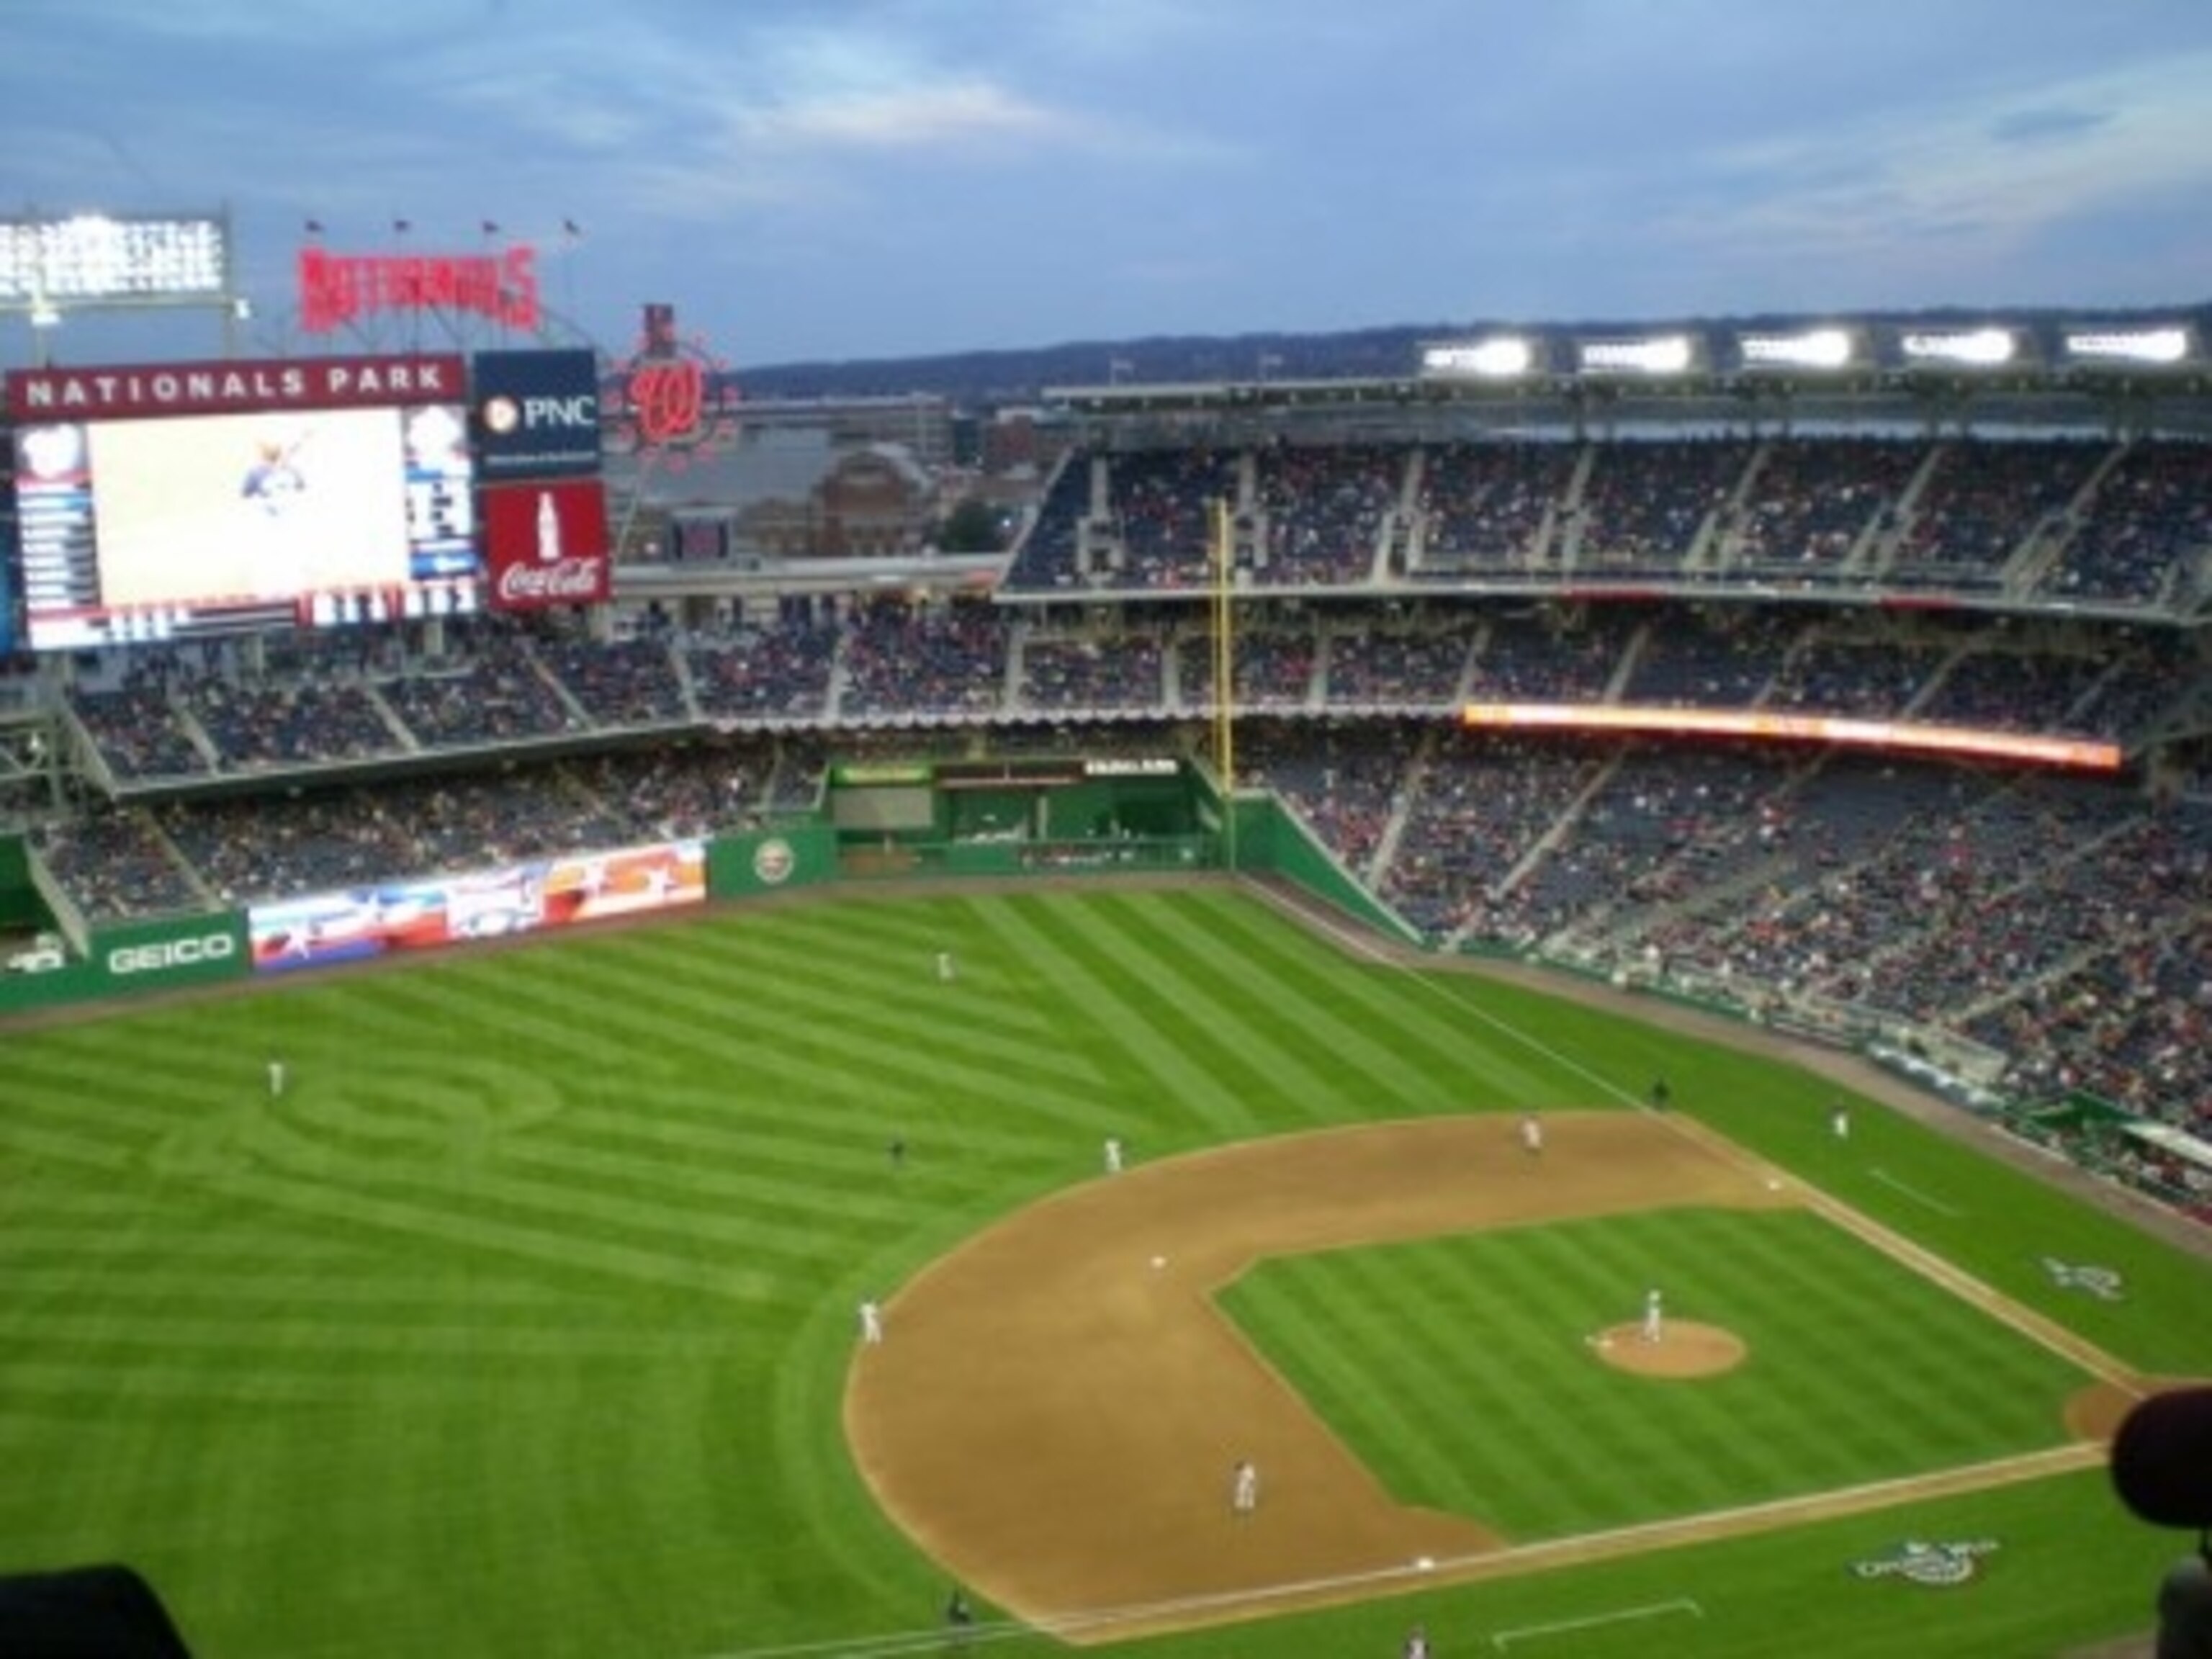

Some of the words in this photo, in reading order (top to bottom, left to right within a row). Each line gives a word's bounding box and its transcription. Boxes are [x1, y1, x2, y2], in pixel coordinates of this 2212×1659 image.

[25, 367, 306, 408] NATIONALS
[325, 362, 443, 395] PARK
[523, 395, 596, 430] PNC
[108, 934, 235, 974] GEICO
